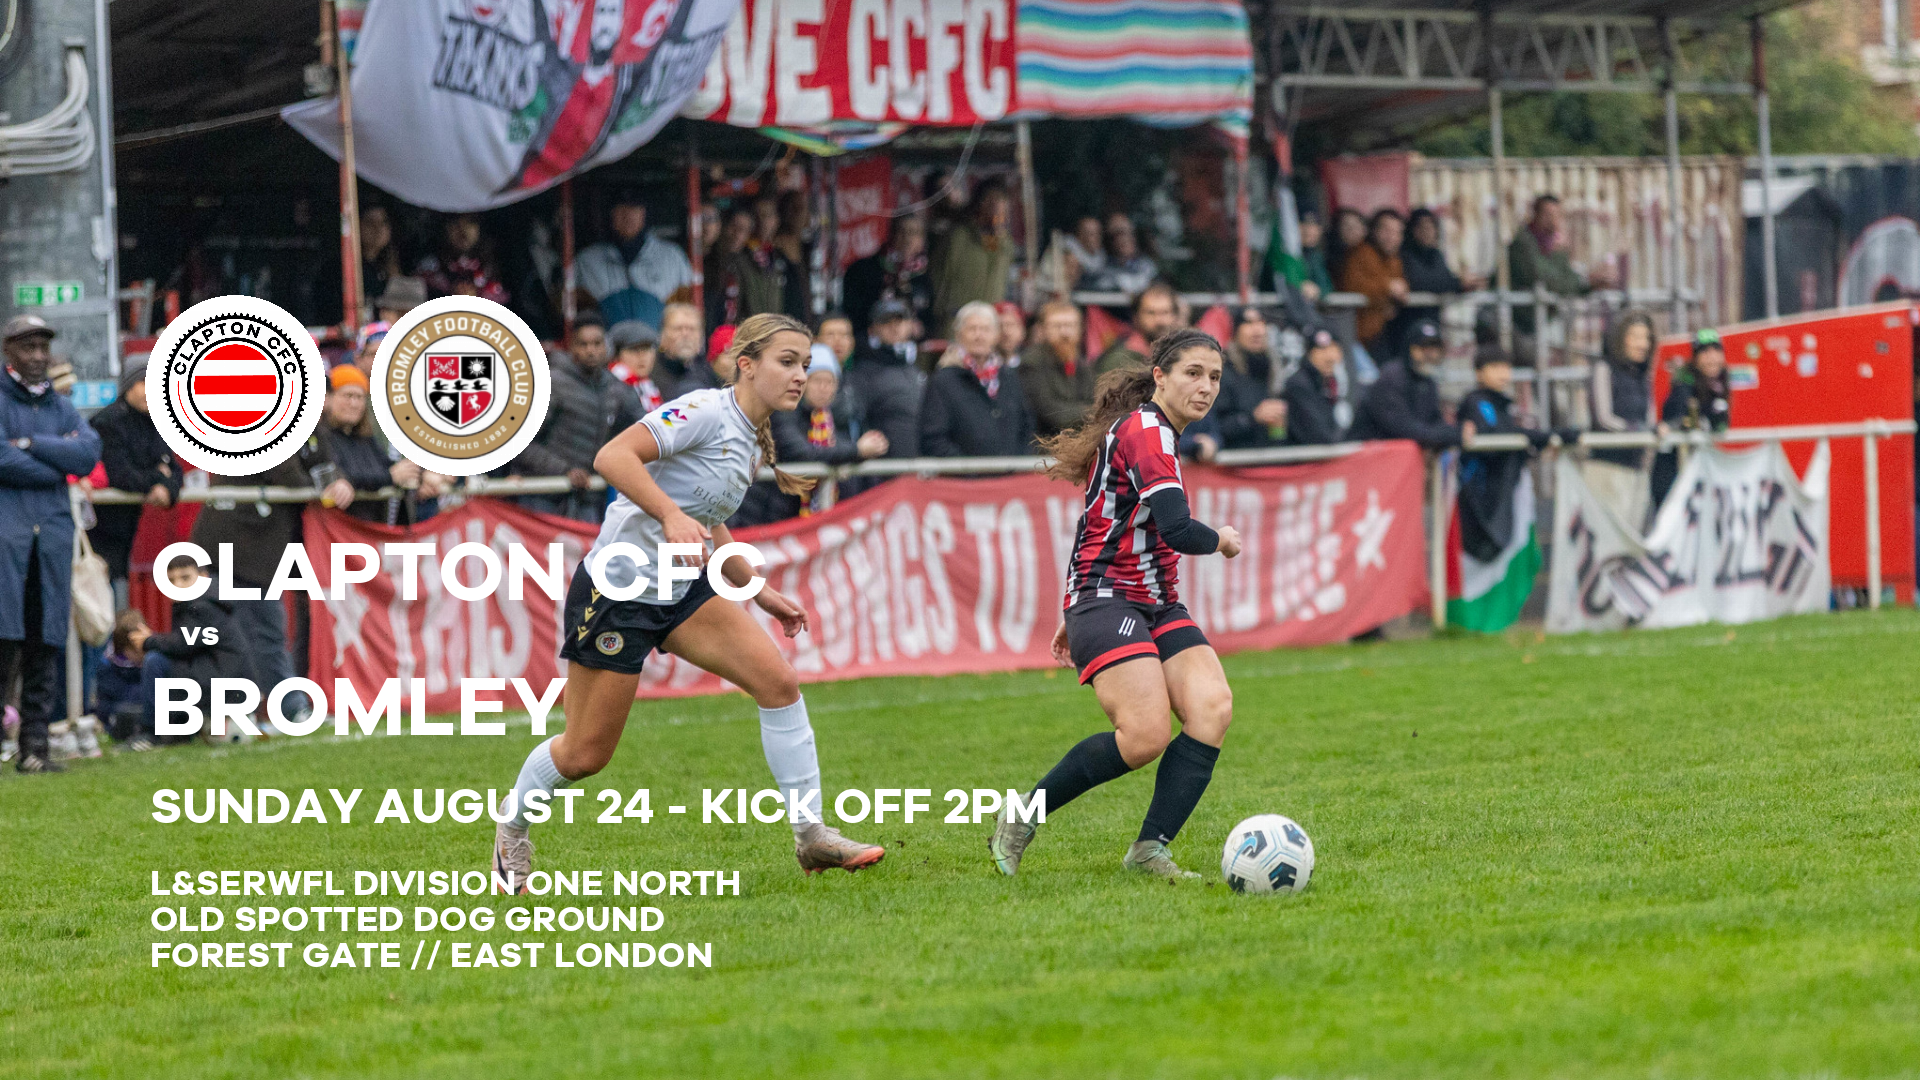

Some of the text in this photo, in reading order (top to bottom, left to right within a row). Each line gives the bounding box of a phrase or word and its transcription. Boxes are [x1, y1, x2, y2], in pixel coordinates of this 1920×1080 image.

[680, 0, 833, 127] OVE
[848, 0, 1010, 121] CCFC
[963, 498, 1039, 653] TO
[1178, 487, 1265, 634] ND
